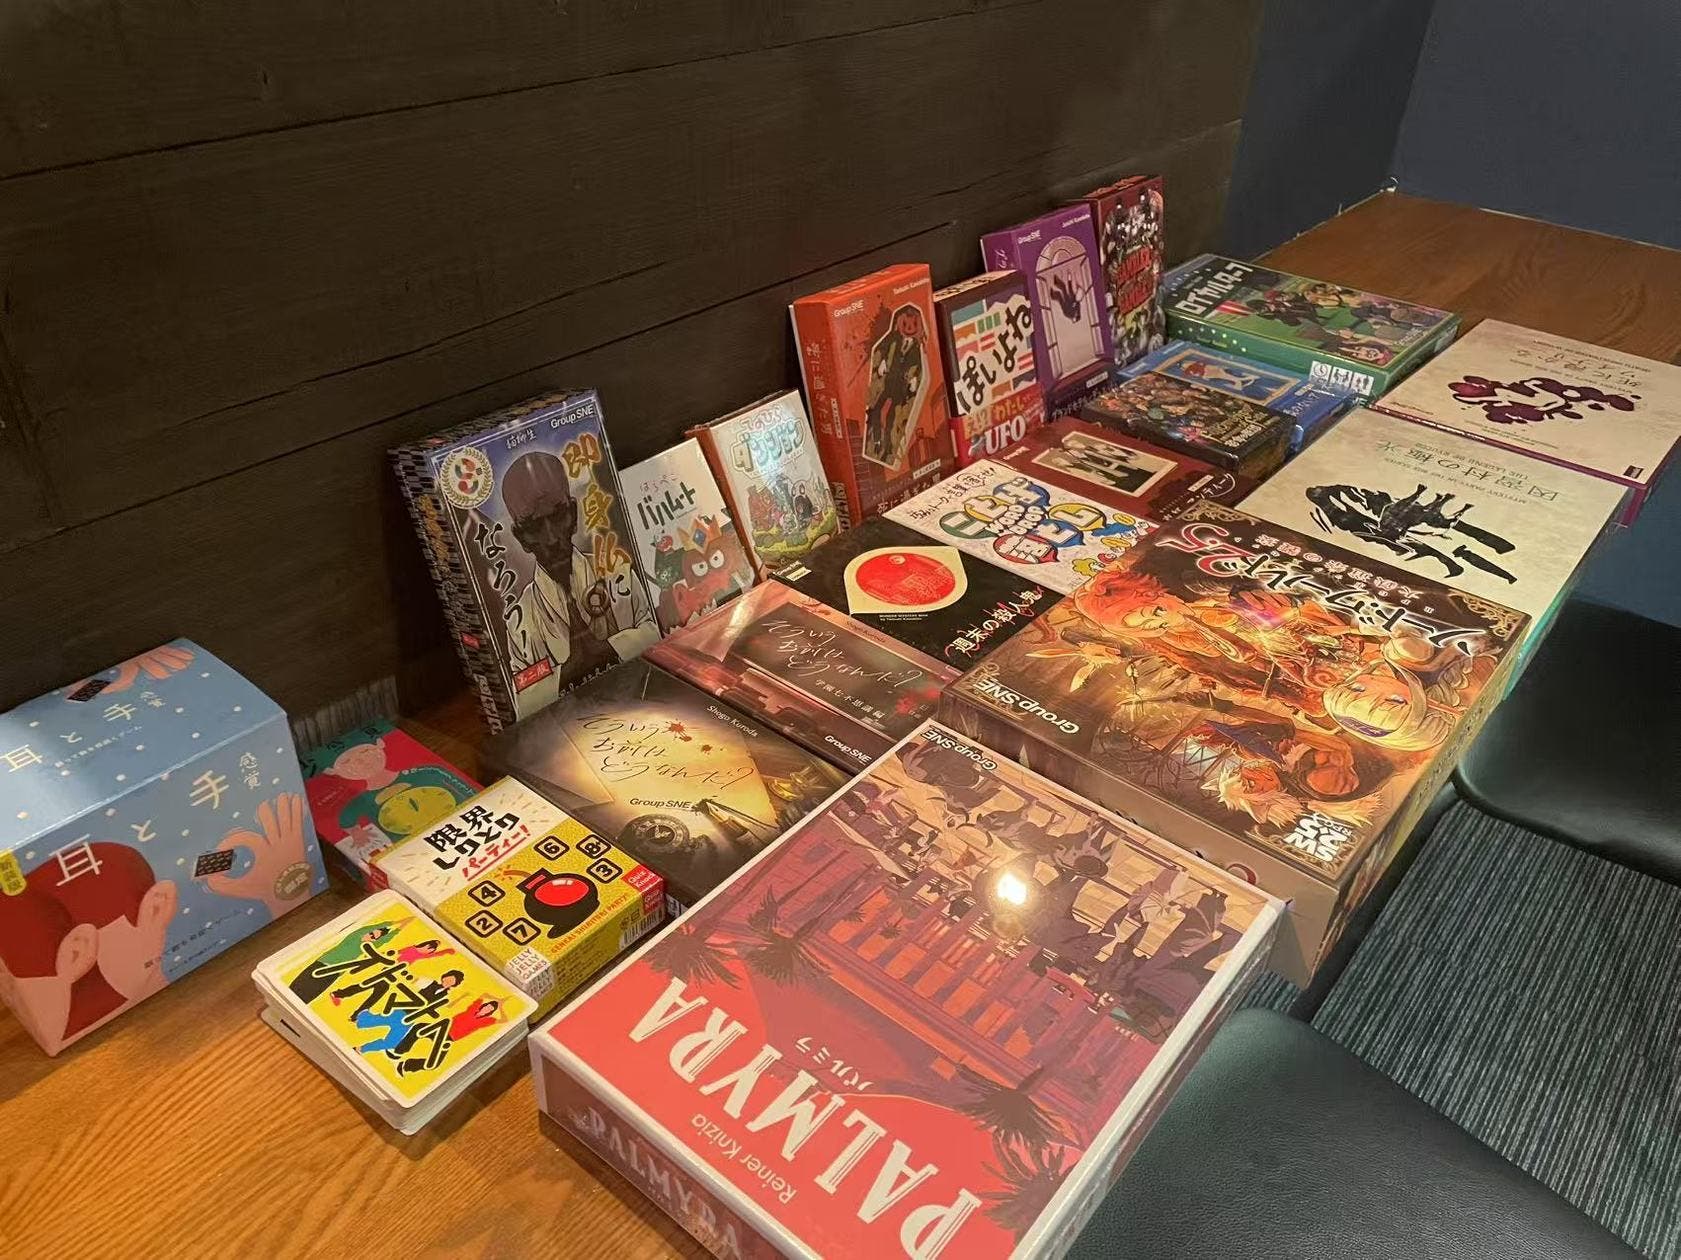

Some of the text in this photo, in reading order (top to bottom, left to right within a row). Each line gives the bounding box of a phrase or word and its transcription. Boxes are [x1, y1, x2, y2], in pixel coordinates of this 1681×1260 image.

[956, 303, 1032, 414] ぽいよね
[550, 404, 595, 429] Group SNE
[984, 414, 1027, 455] UFO
[984, 503, 1047, 536] WORD DROP
[951, 588, 1043, 655] 週末の殺人鬼
[706, 704, 760, 738] Shogo Kuroda
[973, 677, 1080, 735] Group SNE
[824, 735, 872, 764] Group SNE
[921, 729, 998, 771] Group SNE
[239, 751, 261, 789] 感覚
[629, 797, 692, 810] Group SNE
[423, 805, 494, 853] 限界
[432, 812, 521, 871] しりとり
[543, 842, 560, 854] 6
[1282, 831, 1337, 863] SW
[596, 863, 613, 878] 3
[480, 885, 498, 901] 4
[475, 917, 491, 931] 2
[511, 924, 528, 939] 7
[508, 948, 533, 970] JELLY
[516, 953, 541, 977] JELLY
[522, 960, 548, 981] GAMES
[793, 1036, 874, 1092] パルミラ
[628, 975, 983, 1260] PALMYRA
[690, 1113, 798, 1205] Reiner Knizia
